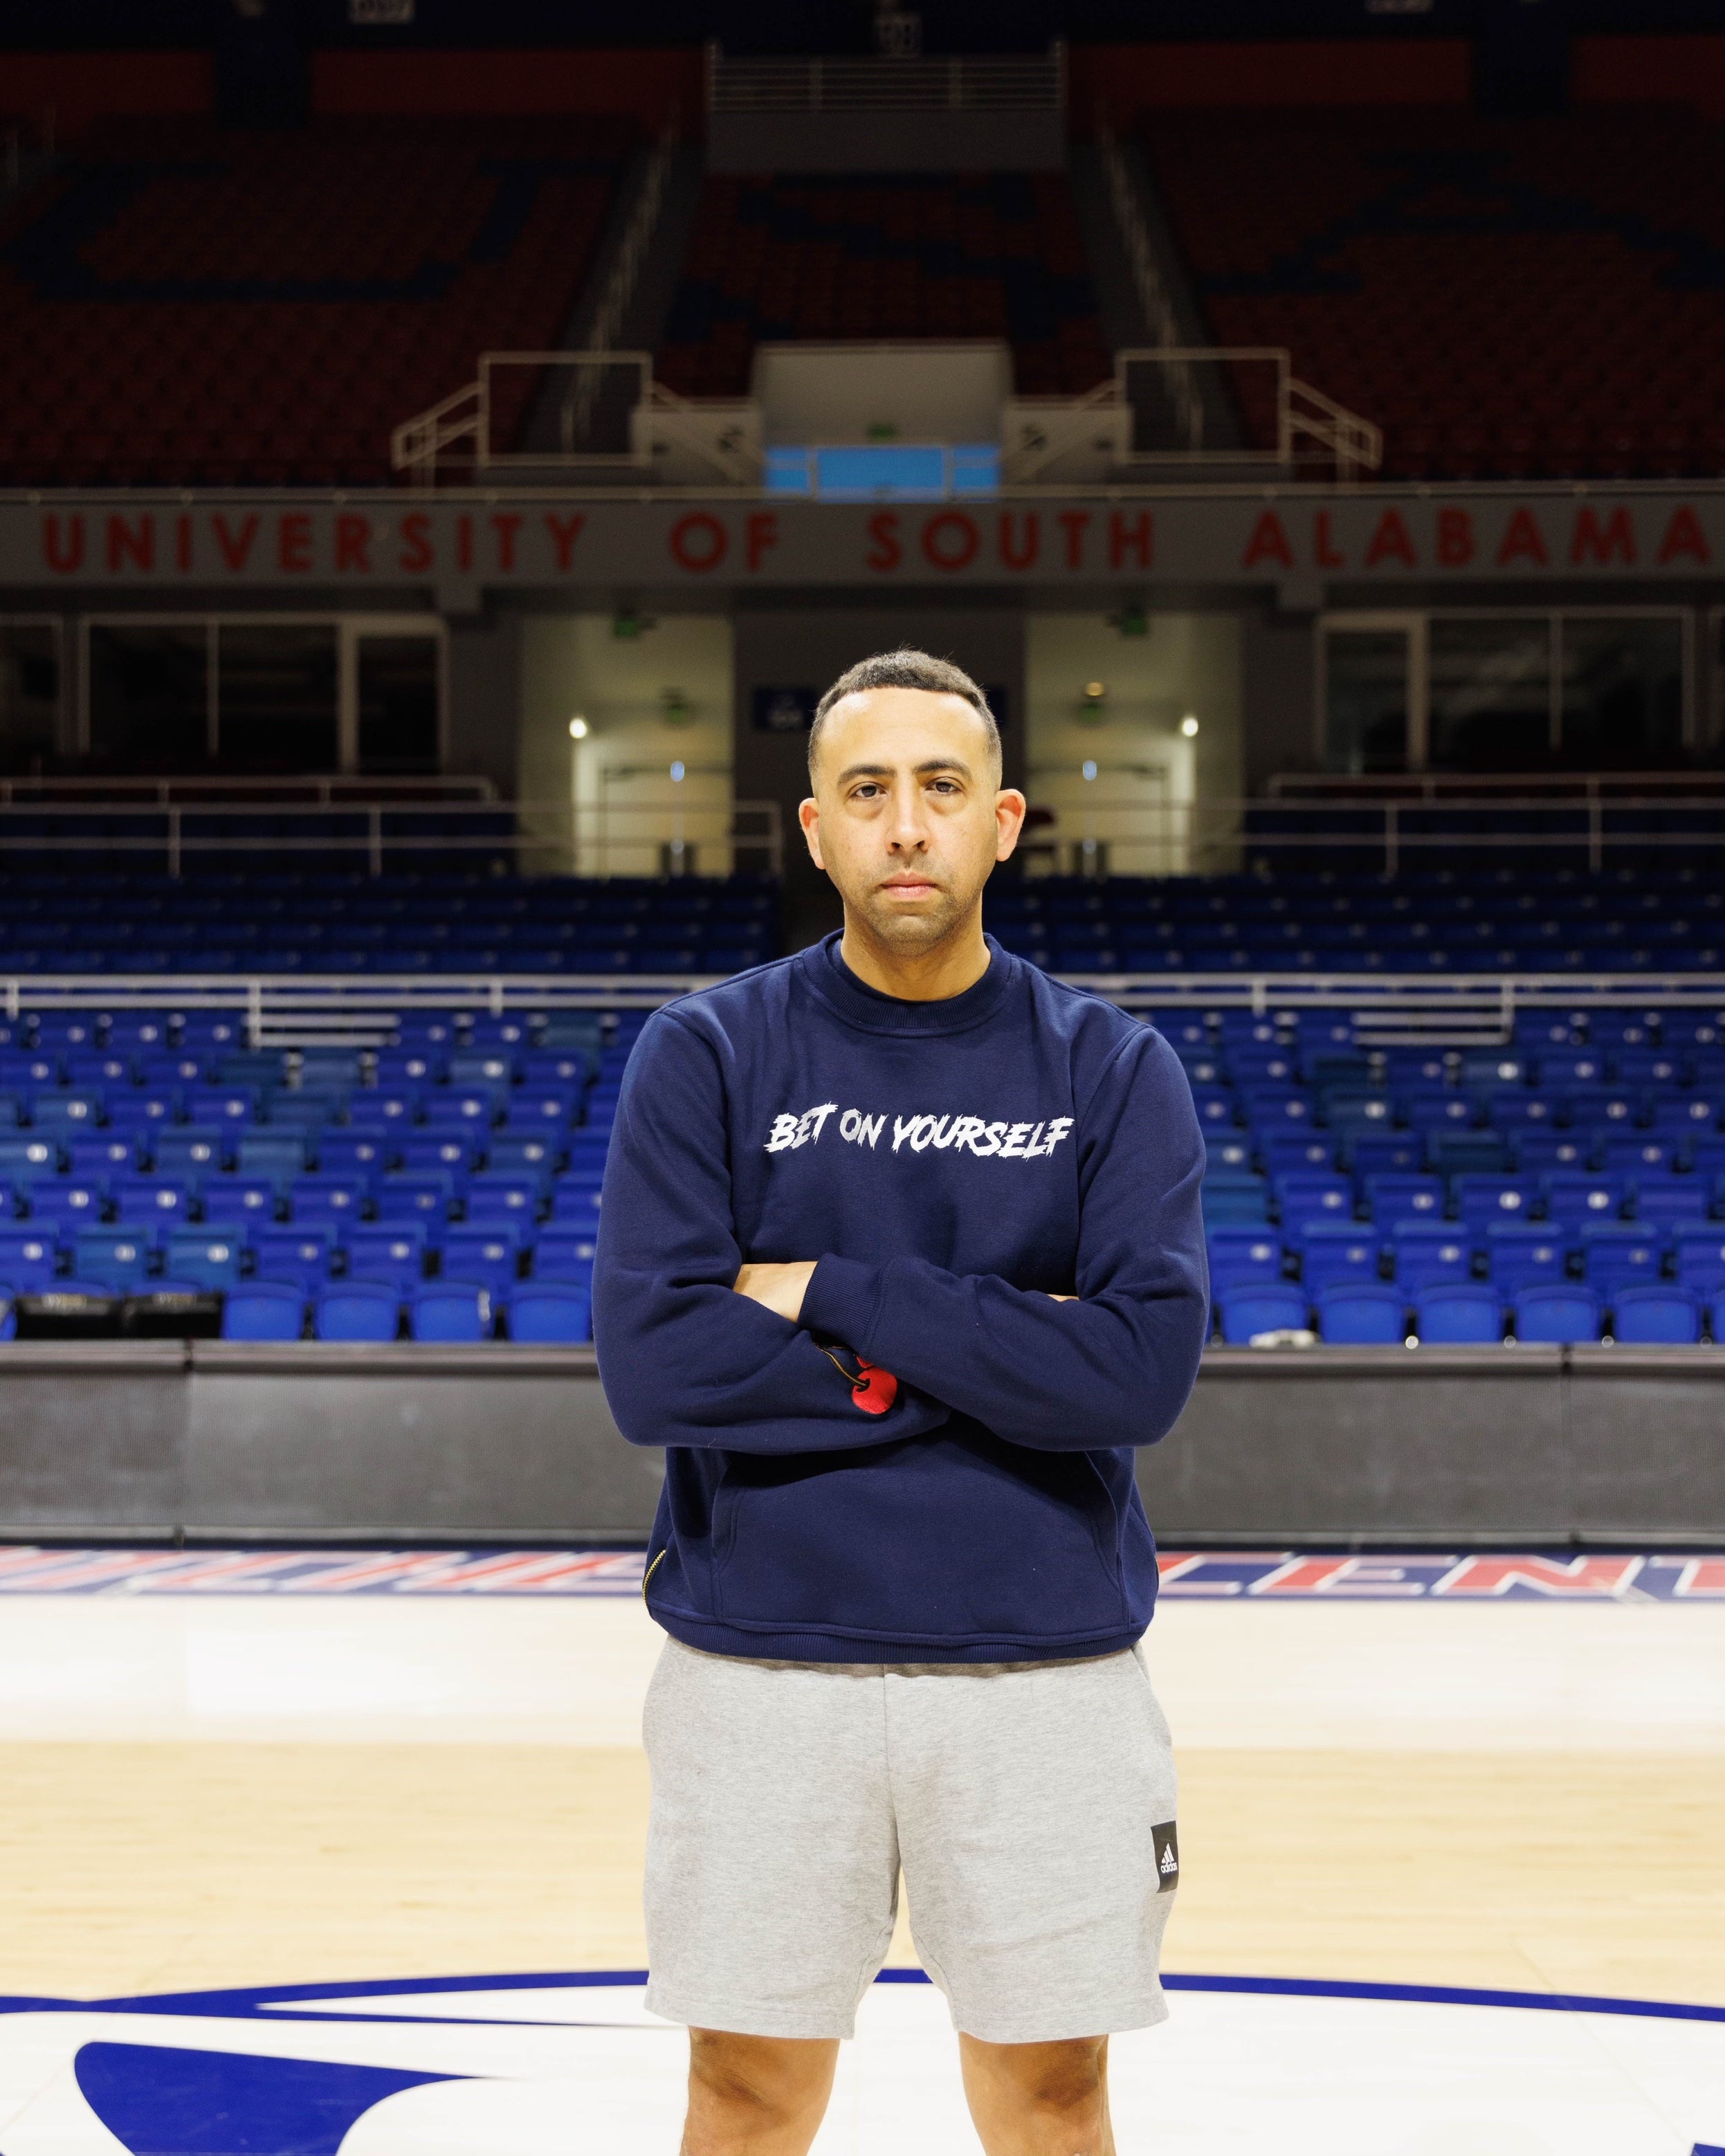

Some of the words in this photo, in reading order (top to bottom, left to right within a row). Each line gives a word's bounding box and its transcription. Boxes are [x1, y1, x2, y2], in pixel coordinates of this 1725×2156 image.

[43, 512, 586, 574] UNIVERSITY
[669, 511, 780, 574] OF
[866, 509, 1153, 571] SOUTH
[1241, 505, 1712, 569] ALABAMA
[763, 1101, 839, 1153] BET
[839, 1108, 889, 1151] ON
[891, 1113, 1075, 1162] YOURSELF
[1160, 1861, 1178, 1874] adidas
